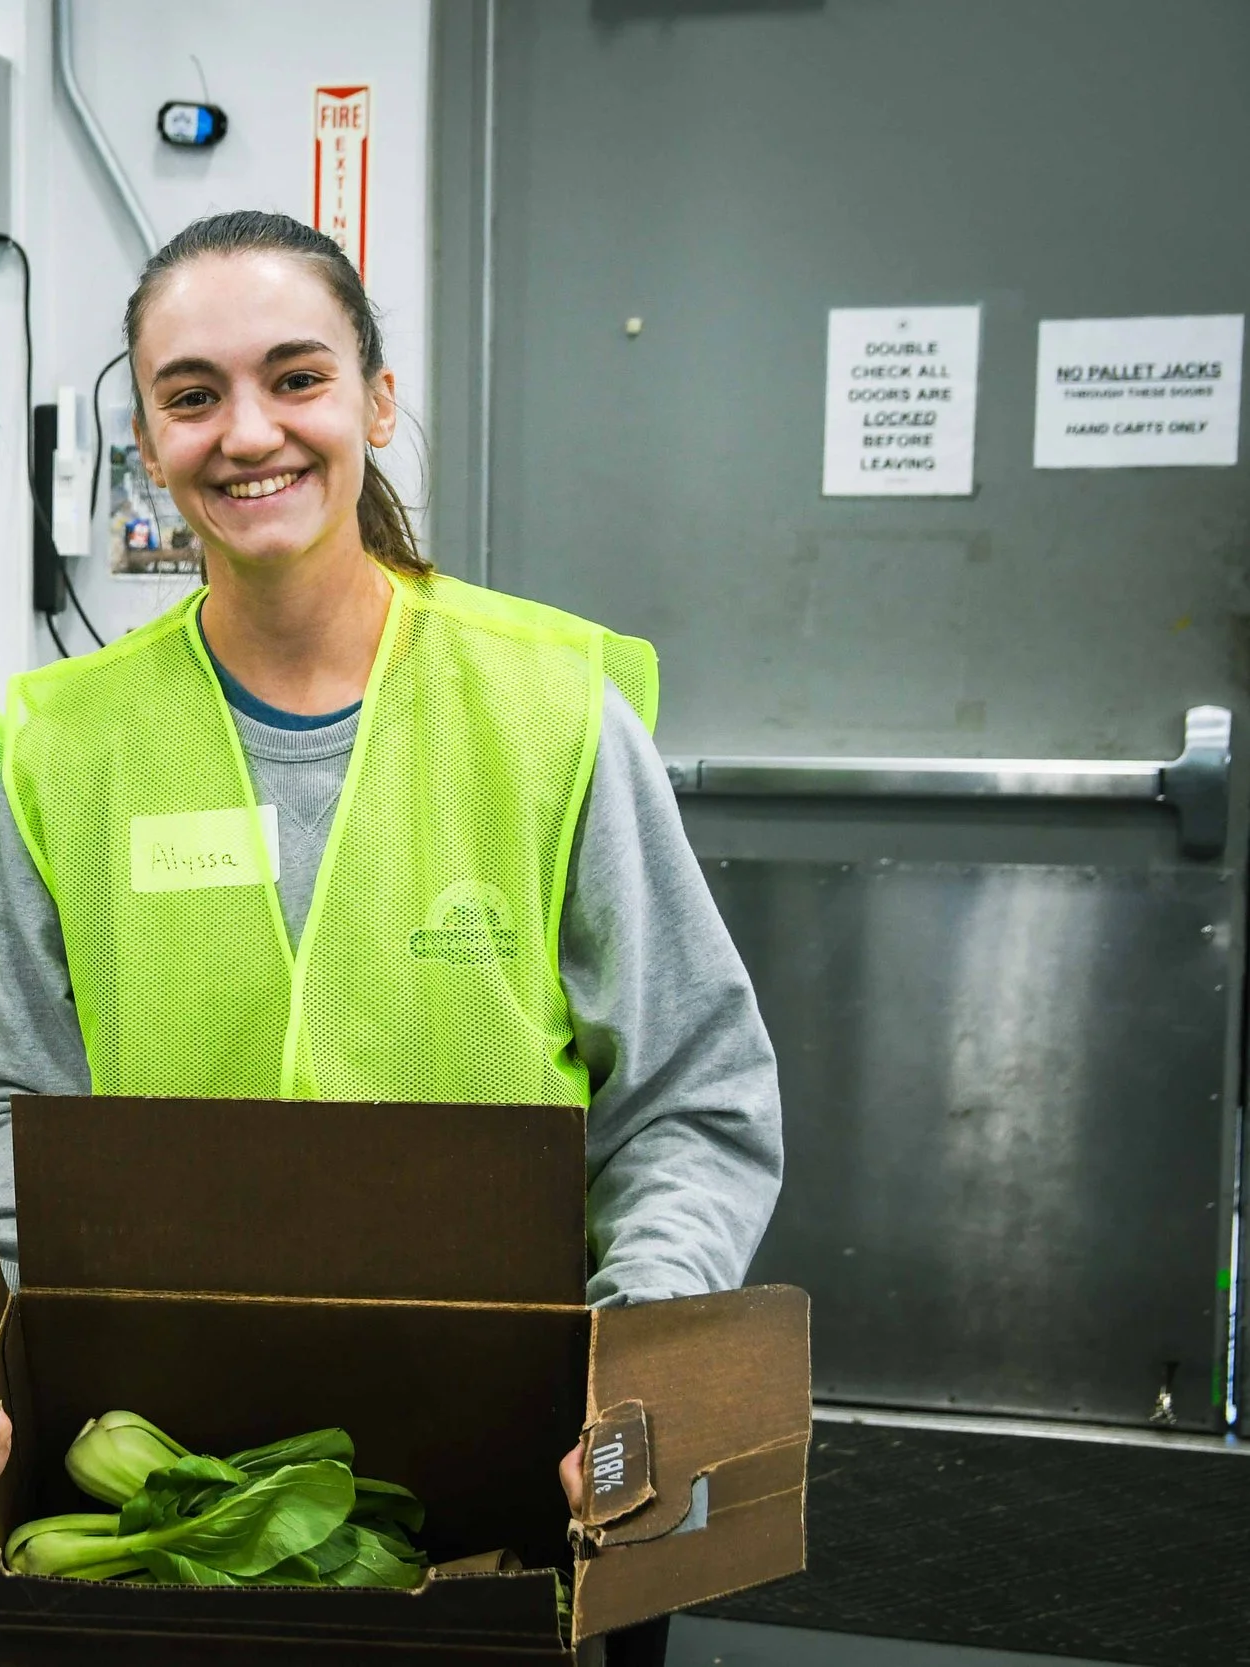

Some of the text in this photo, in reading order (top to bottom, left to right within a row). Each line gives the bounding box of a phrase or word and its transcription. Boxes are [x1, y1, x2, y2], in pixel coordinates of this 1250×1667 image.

[321, 105, 361, 129] FIRE
[865, 342, 938, 357] DOUBLE
[851, 365, 950, 379] CHECK ALL
[1056, 361, 1222, 381] NO PALLET JACKS
[848, 388, 952, 402] DOORS ARE
[863, 411, 938, 427] LOCKED
[1065, 421, 1208, 435] HAND CARTS ONLY
[862, 434, 933, 447] BEFORE
[860, 457, 936, 471] LEAVING
[151, 842, 238, 875] Alyssa
